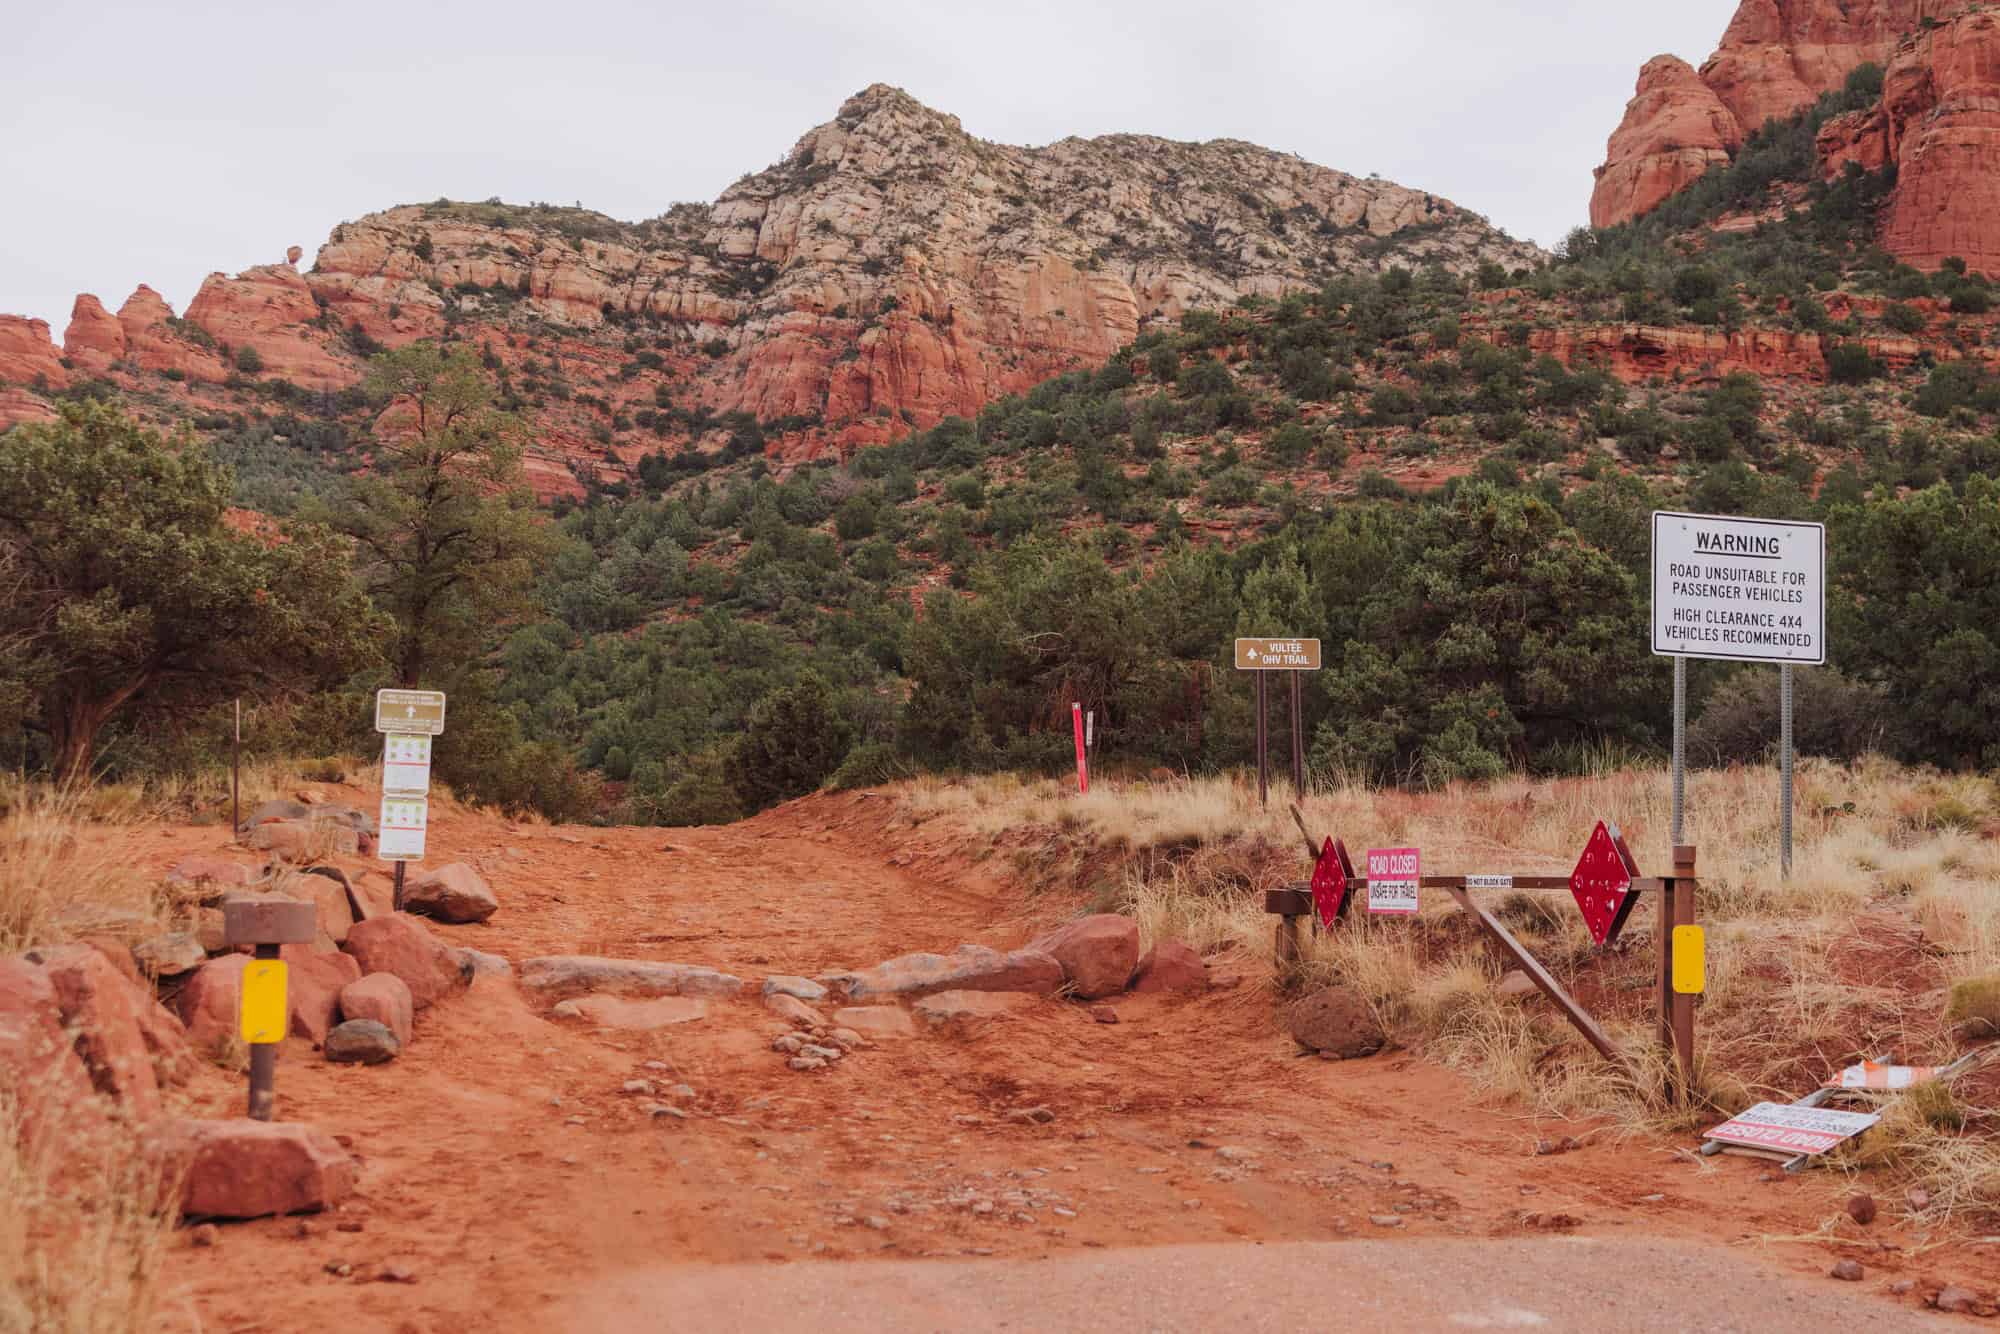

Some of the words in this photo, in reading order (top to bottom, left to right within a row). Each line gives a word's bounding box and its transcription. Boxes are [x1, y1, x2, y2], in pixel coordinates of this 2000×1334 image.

[1696, 532, 1779, 554] WARNING
[1670, 563, 1700, 579] ROAD
[1705, 566, 1777, 584] UNSUITABLE
[1783, 572, 1806, 585] FOR
[1673, 583, 1740, 600] PASSENGER
[1745, 588, 1802, 603] VEHICLES
[1673, 607, 1701, 622] HIGH
[1706, 610, 1775, 627] CLEARANCE
[1779, 615, 1802, 628] 4X4
[1665, 625, 1719, 641] VEHICLES
[1723, 629, 1811, 647] RECOMMENDED
[1270, 643, 1303, 653] VULTEE
[1262, 655, 1281, 664] OHV
[1284, 655, 1309, 664] TRAIL
[1370, 855, 1388, 874] ROAD
[1390, 854, 1417, 874] CLOSED
[1370, 883, 1388, 899] UNSAFE
[1389, 883, 1398, 898] FOR
[1399, 883, 1416, 898] TRAVEL
